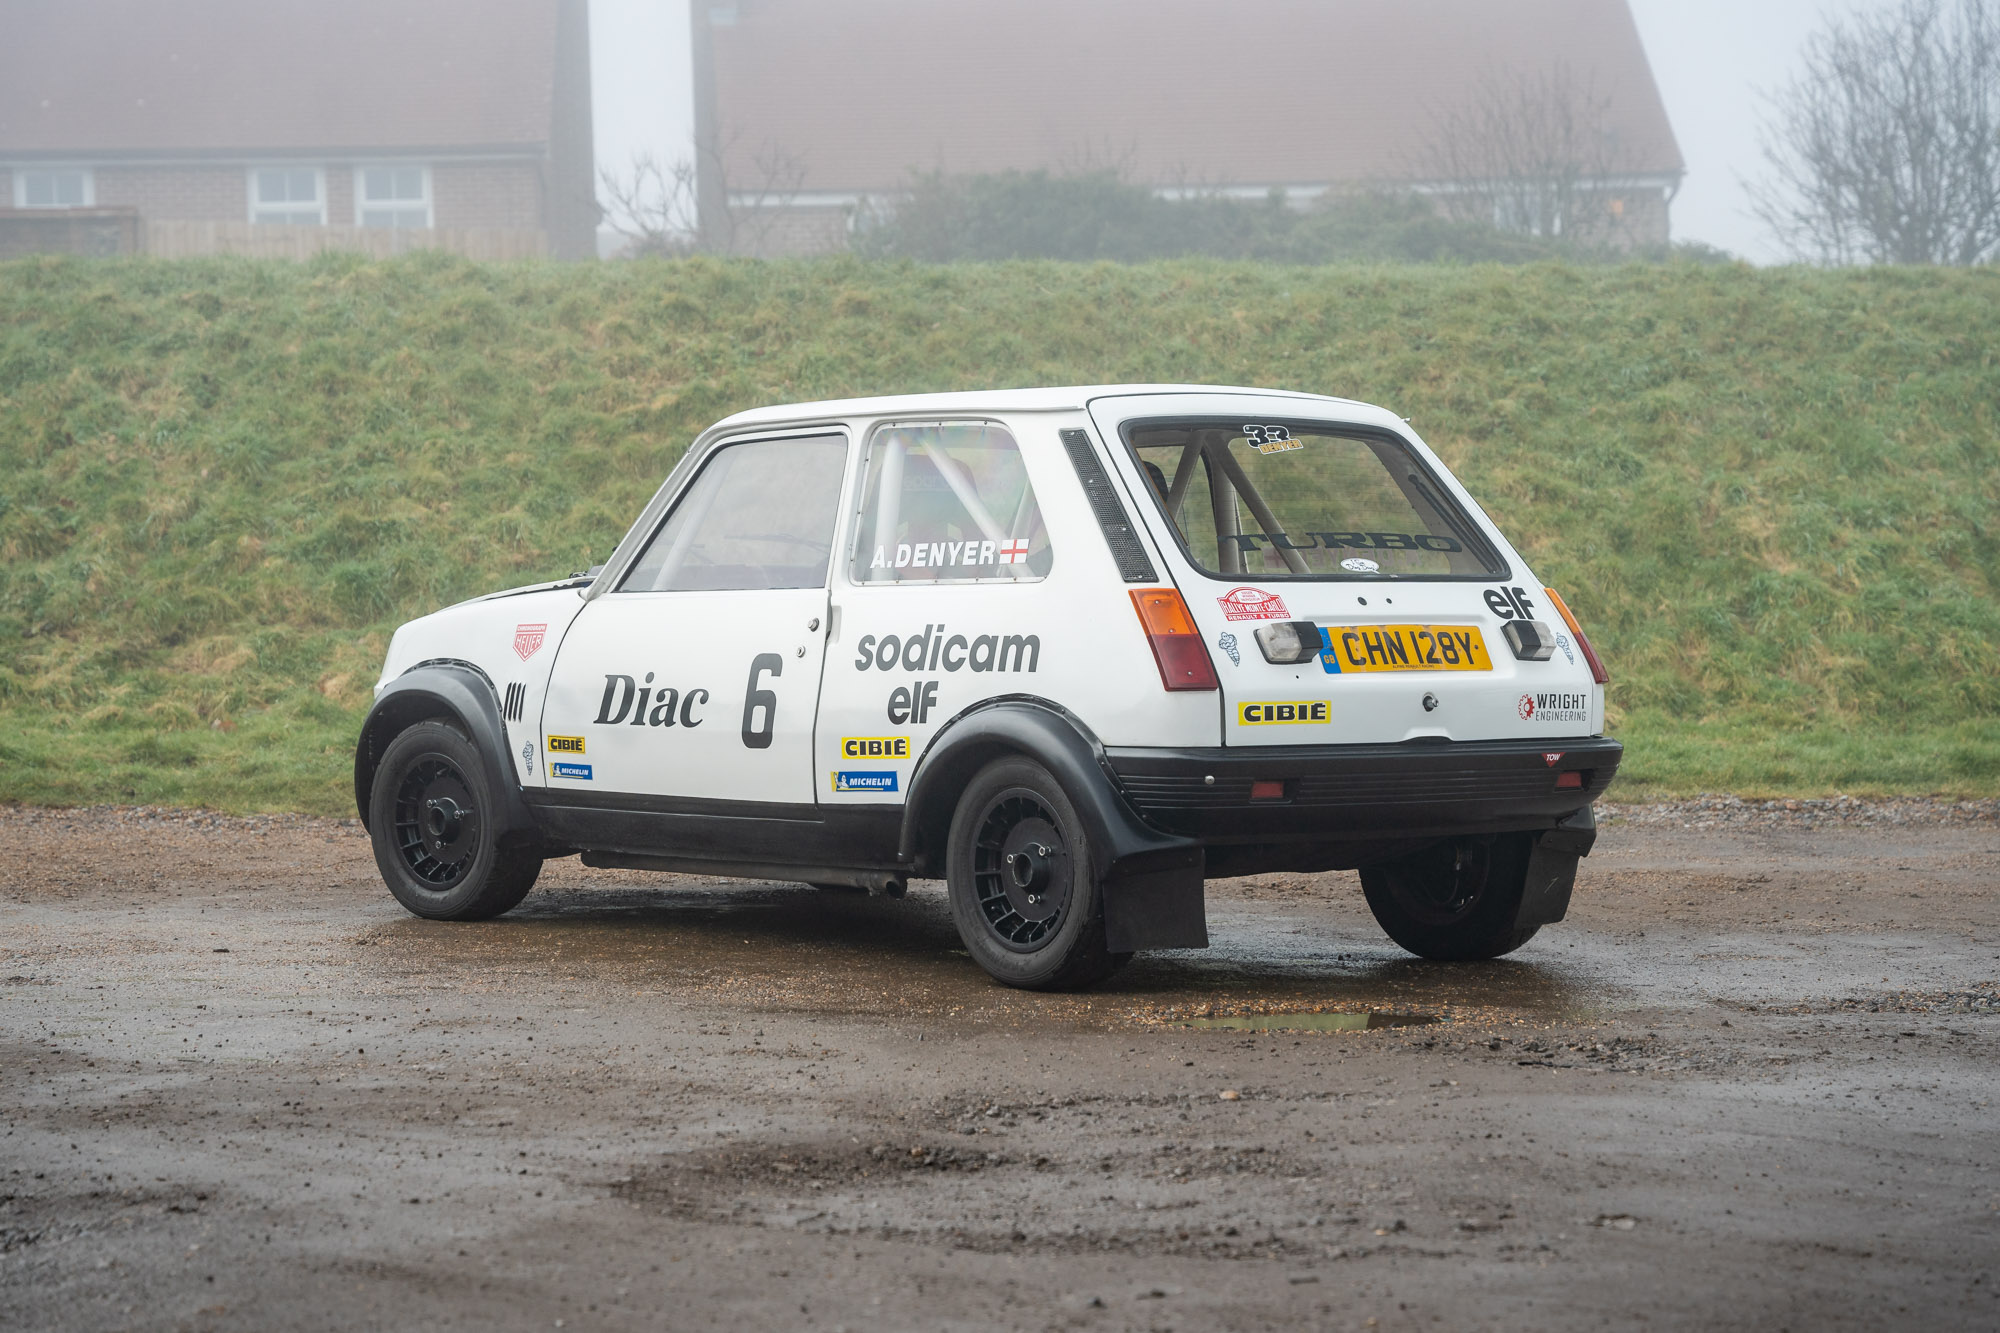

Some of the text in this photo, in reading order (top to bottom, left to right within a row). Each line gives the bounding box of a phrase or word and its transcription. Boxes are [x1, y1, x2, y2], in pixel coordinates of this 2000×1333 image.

[1243, 424, 1290, 449] 33
[1258, 438, 1304, 455] DENYER
[1217, 532, 1463, 552] TURBO
[870, 540, 996, 569] A.DENYER
[1220, 600, 1246, 614] RALLYE
[1244, 598, 1286, 613] MONTE-CARLO
[1483, 586, 1535, 620] elf
[515, 635, 542, 656] HEUER
[855, 624, 1040, 673] sodicam
[1341, 631, 1475, 666] CHN 128Y
[1323, 654, 1336, 664] GB
[593, 671, 710, 728] Diac
[741, 653, 783, 749] 6
[888, 681, 939, 725] elf
[1536, 694, 1586, 710] WRIGHT
[1243, 703, 1326, 722] CIBIÉ
[1535, 711, 1586, 722] ENGINEERING
[845, 739, 906, 756] CIBIÉ
[1546, 753, 1561, 761] TOW
[561, 768, 589, 776] MICHELIN
[849, 778, 892, 786] MICHELIN
